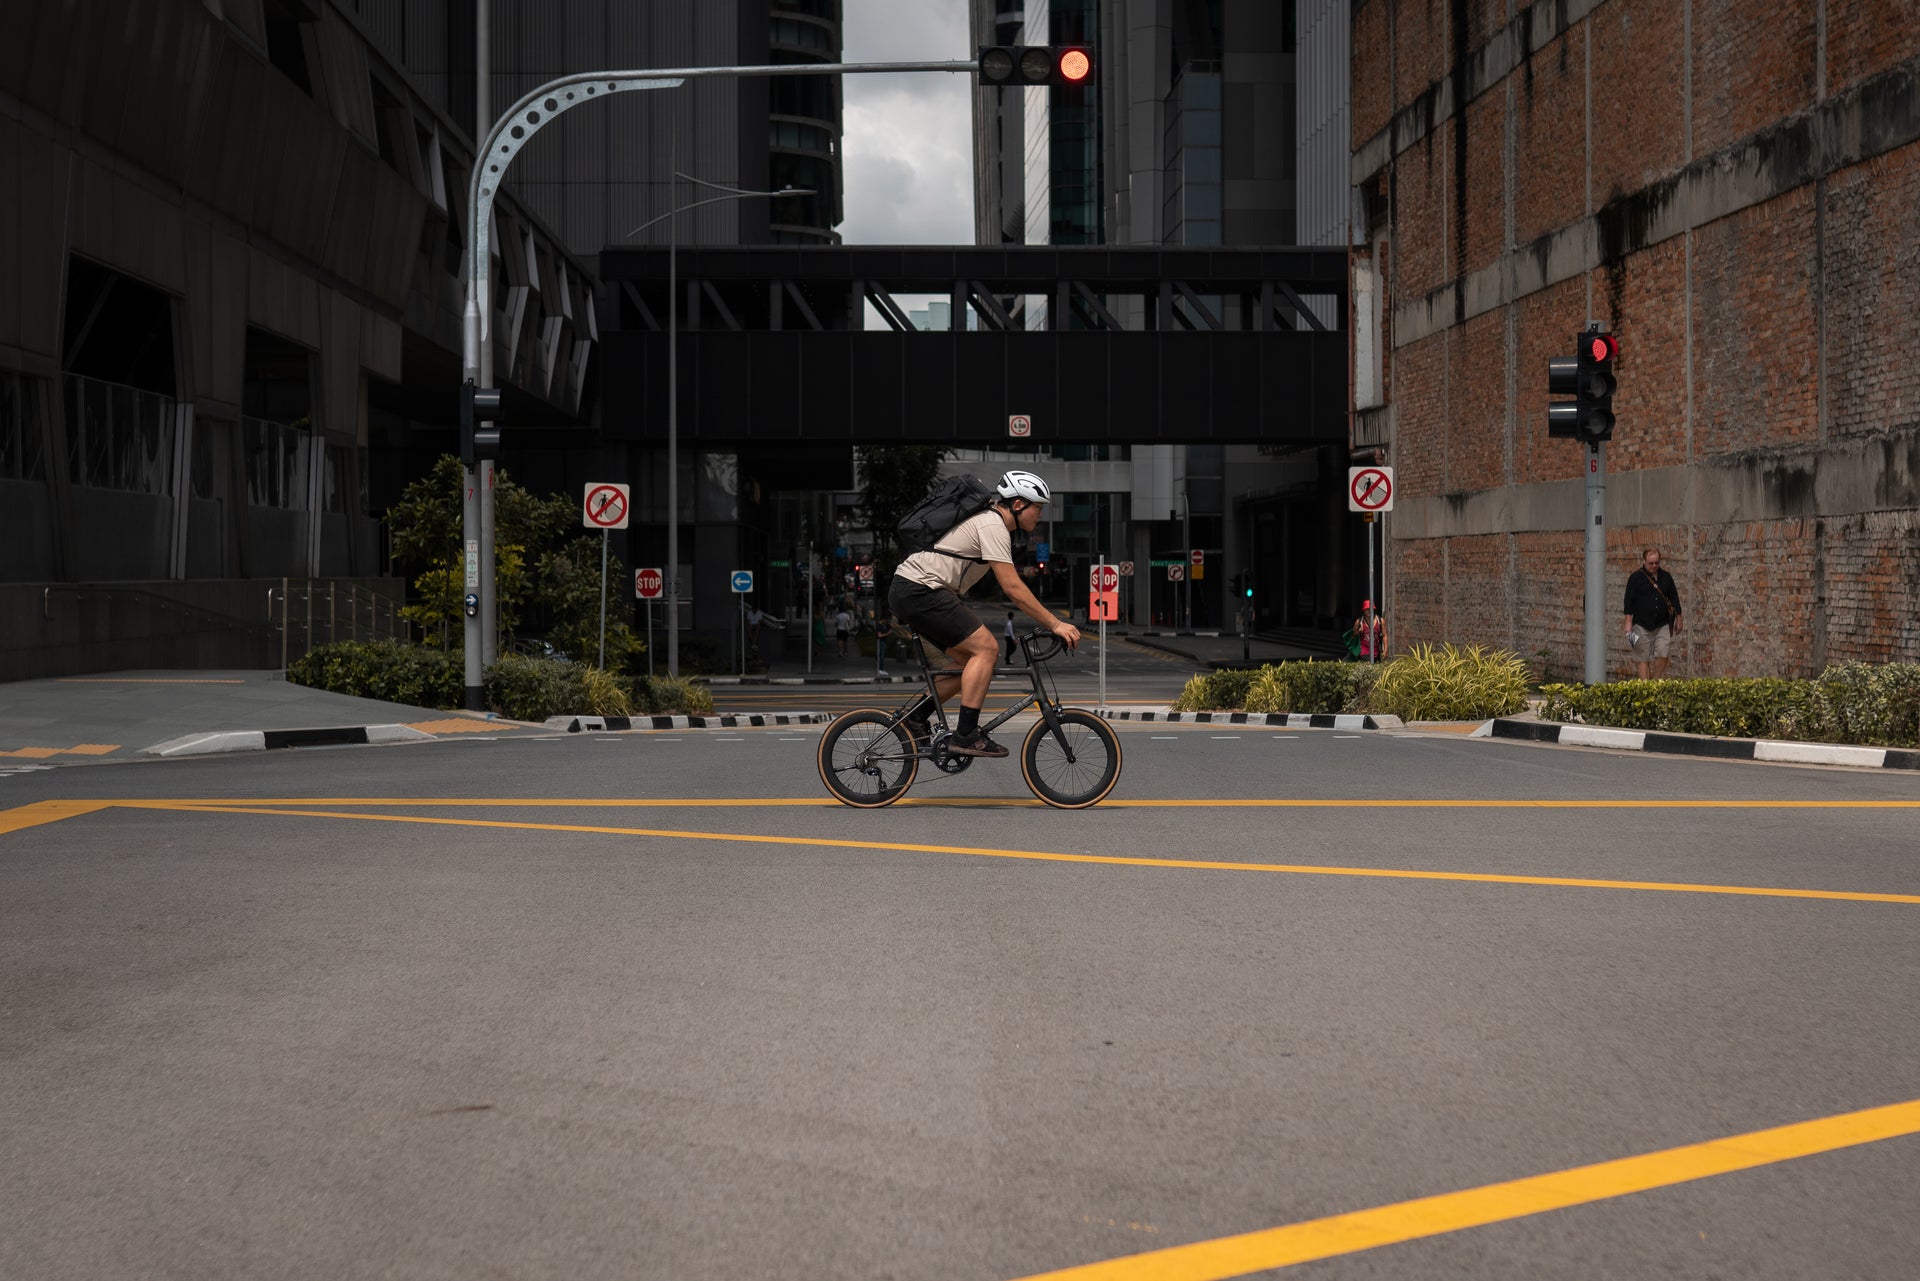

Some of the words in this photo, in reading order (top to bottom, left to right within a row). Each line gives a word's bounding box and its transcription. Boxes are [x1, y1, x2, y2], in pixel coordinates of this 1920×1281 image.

[1591, 460, 1597, 473] 6
[468, 488, 474, 501] 7
[637, 577, 661, 589] STOP
[1092, 574, 1118, 585] SOP
